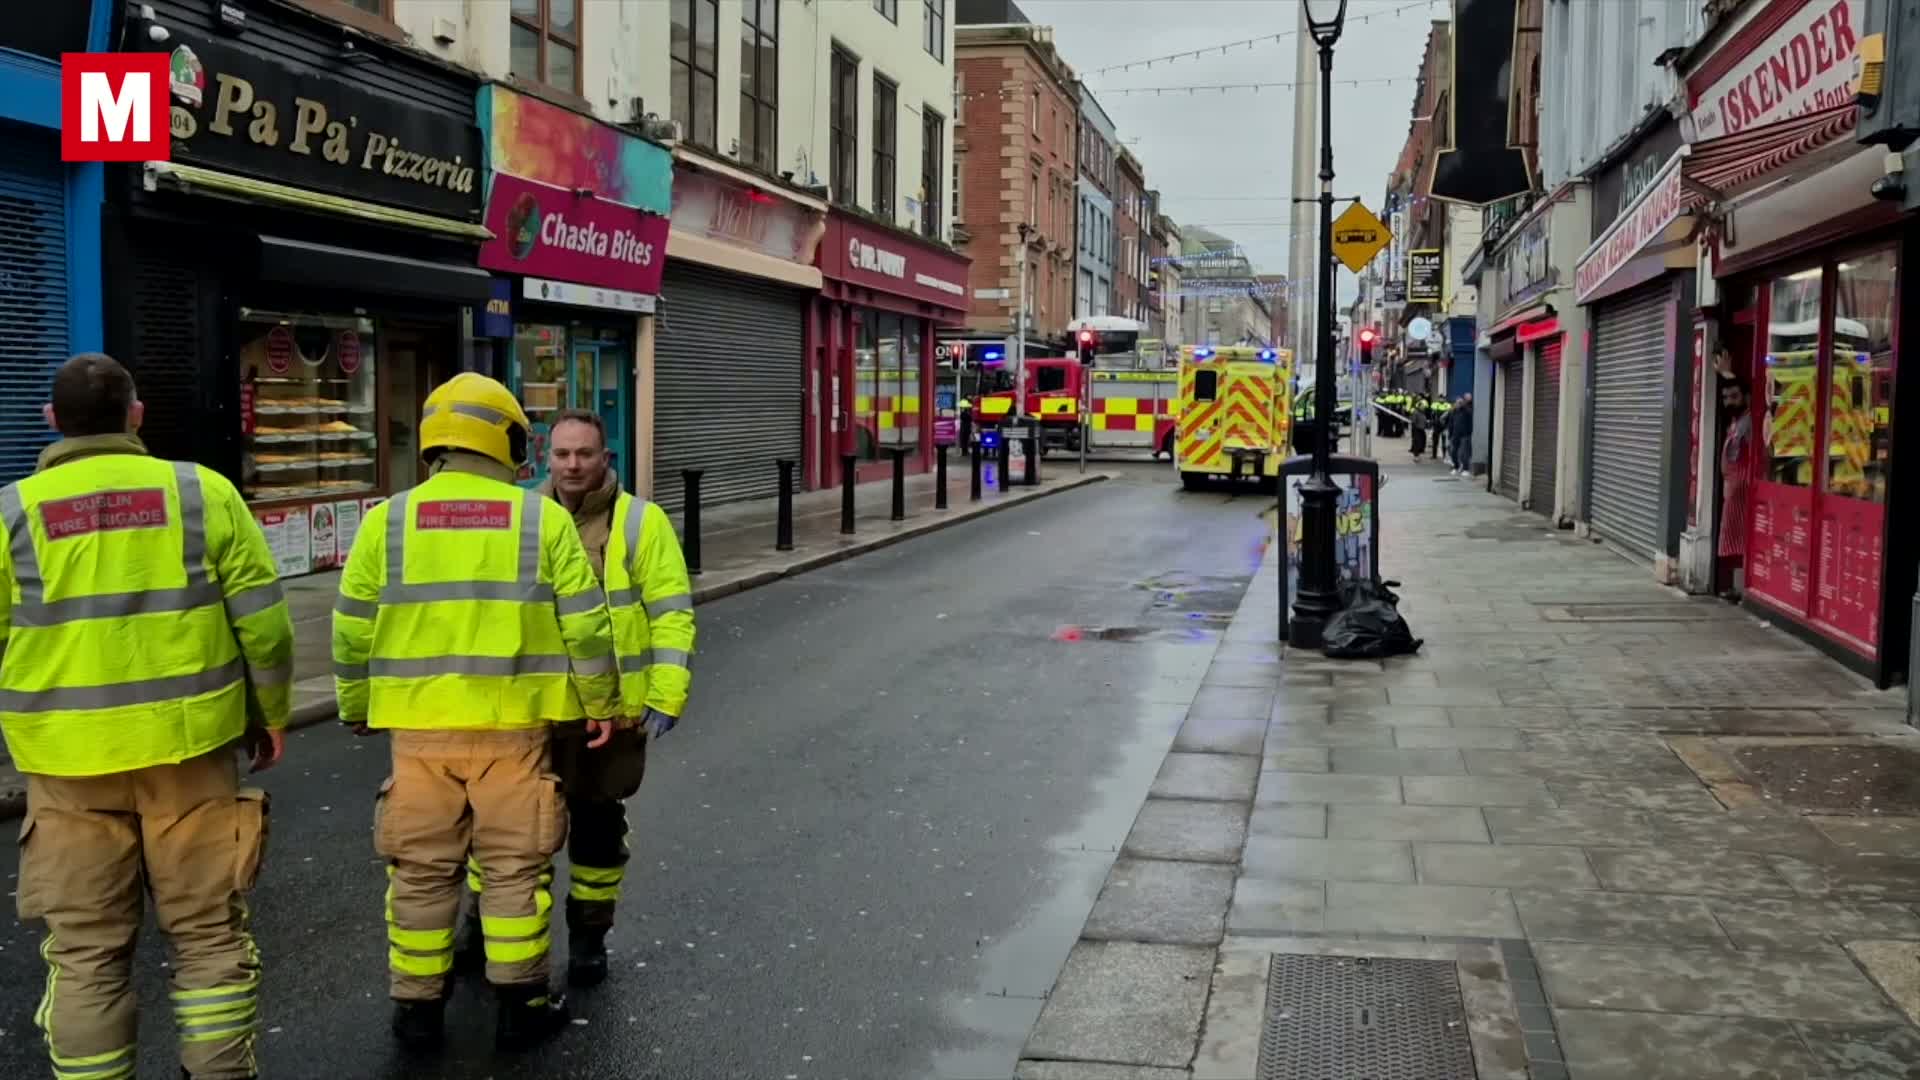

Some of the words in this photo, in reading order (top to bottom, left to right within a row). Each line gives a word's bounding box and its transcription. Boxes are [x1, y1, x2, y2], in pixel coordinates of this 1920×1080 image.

[1718, 0, 1857, 135] ISKENDER
[208, 72, 279, 146] Pa
[361, 132, 475, 193] Pizzeria
[541, 212, 608, 257] Chaska
[610, 229, 653, 267] Bites
[1413, 256, 1424, 265] To
[1425, 255, 1440, 265] Let
[487, 299, 510, 315] ATM
[72, 495, 132, 514] DUBLIN
[440, 502, 489, 513] DUBLIN
[50, 515, 87, 537] FIRE
[91, 509, 162, 532] BRIGADE
[419, 515, 449, 527] FIRE
[451, 514, 506, 527] BRIGADE
